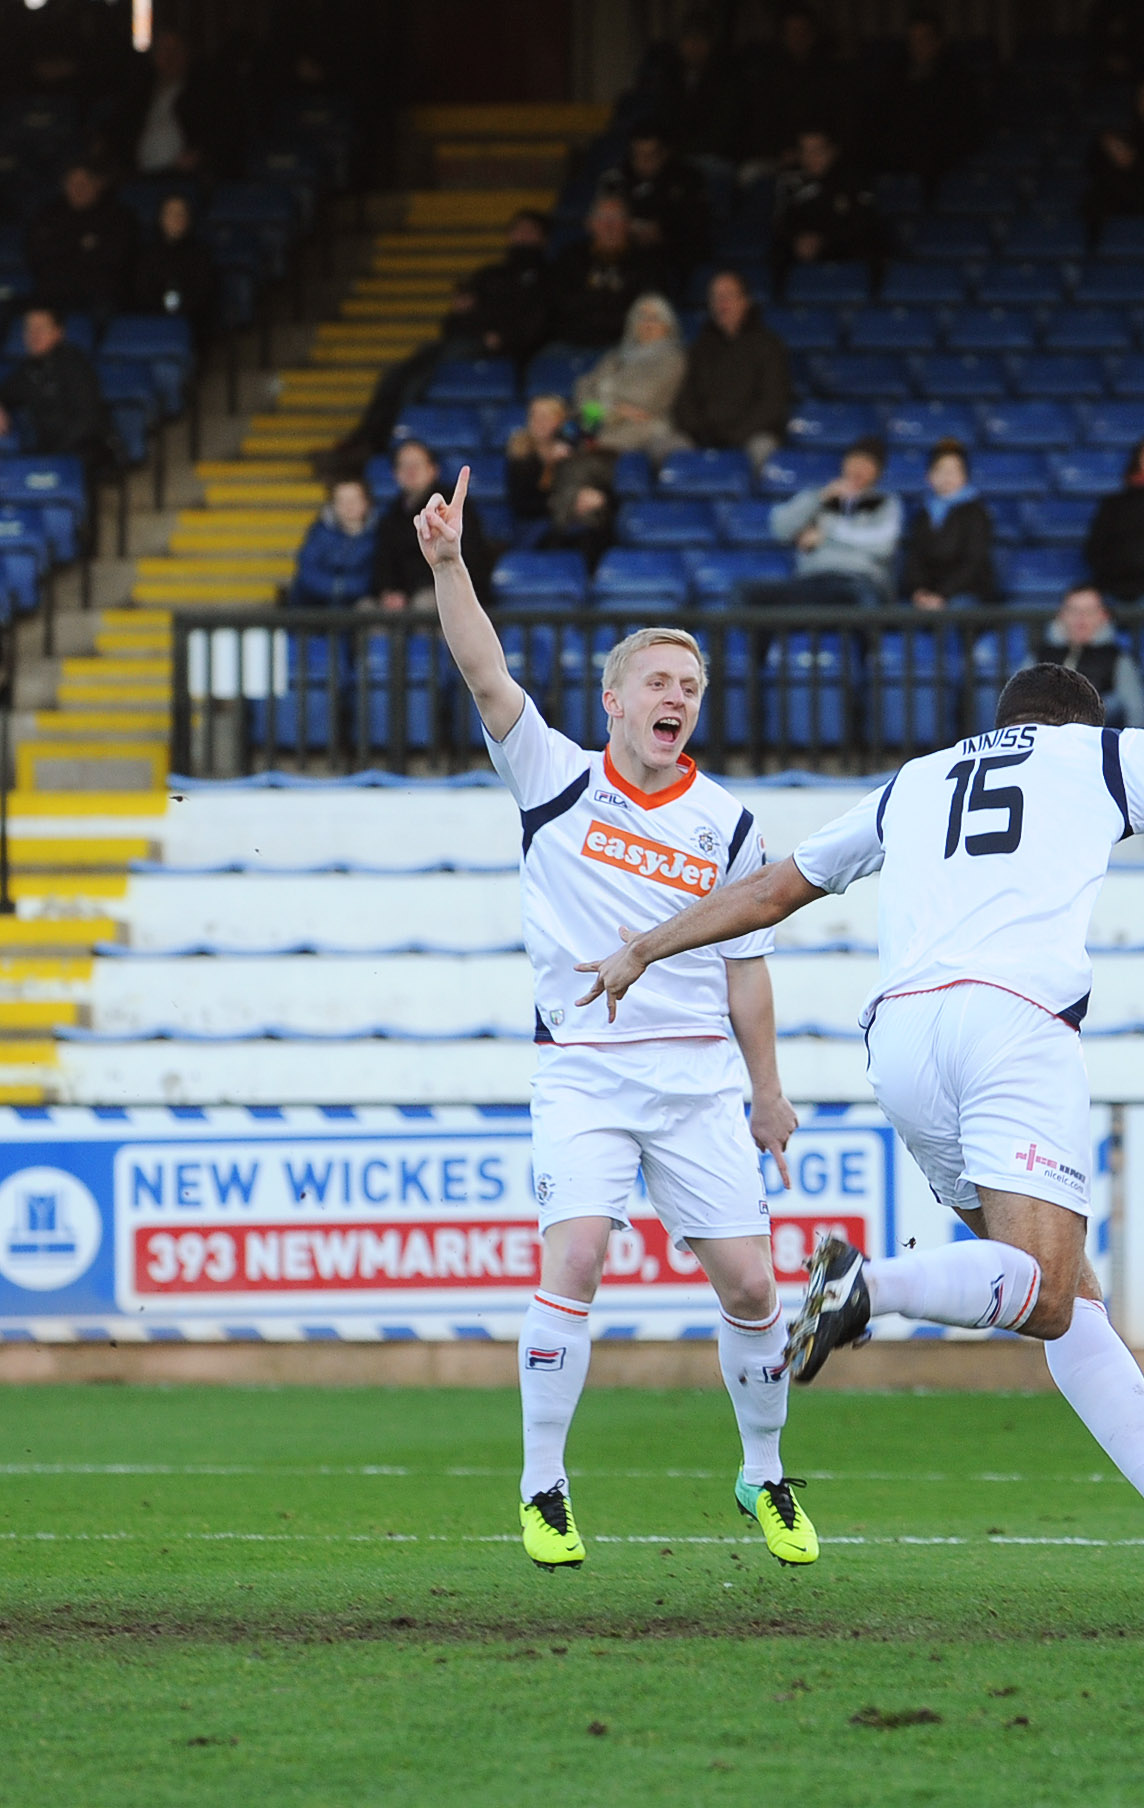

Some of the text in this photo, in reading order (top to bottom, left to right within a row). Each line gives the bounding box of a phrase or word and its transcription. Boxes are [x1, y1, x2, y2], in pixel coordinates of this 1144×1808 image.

[962, 726, 1038, 756] INNISS
[598, 791, 629, 809] FILA
[944, 749, 1035, 860] 15
[586, 829, 717, 892] easyJet
[131, 1162, 260, 1208] NEW
[285, 1157, 505, 1203] WICKES
[146, 1231, 238, 1283] 393
